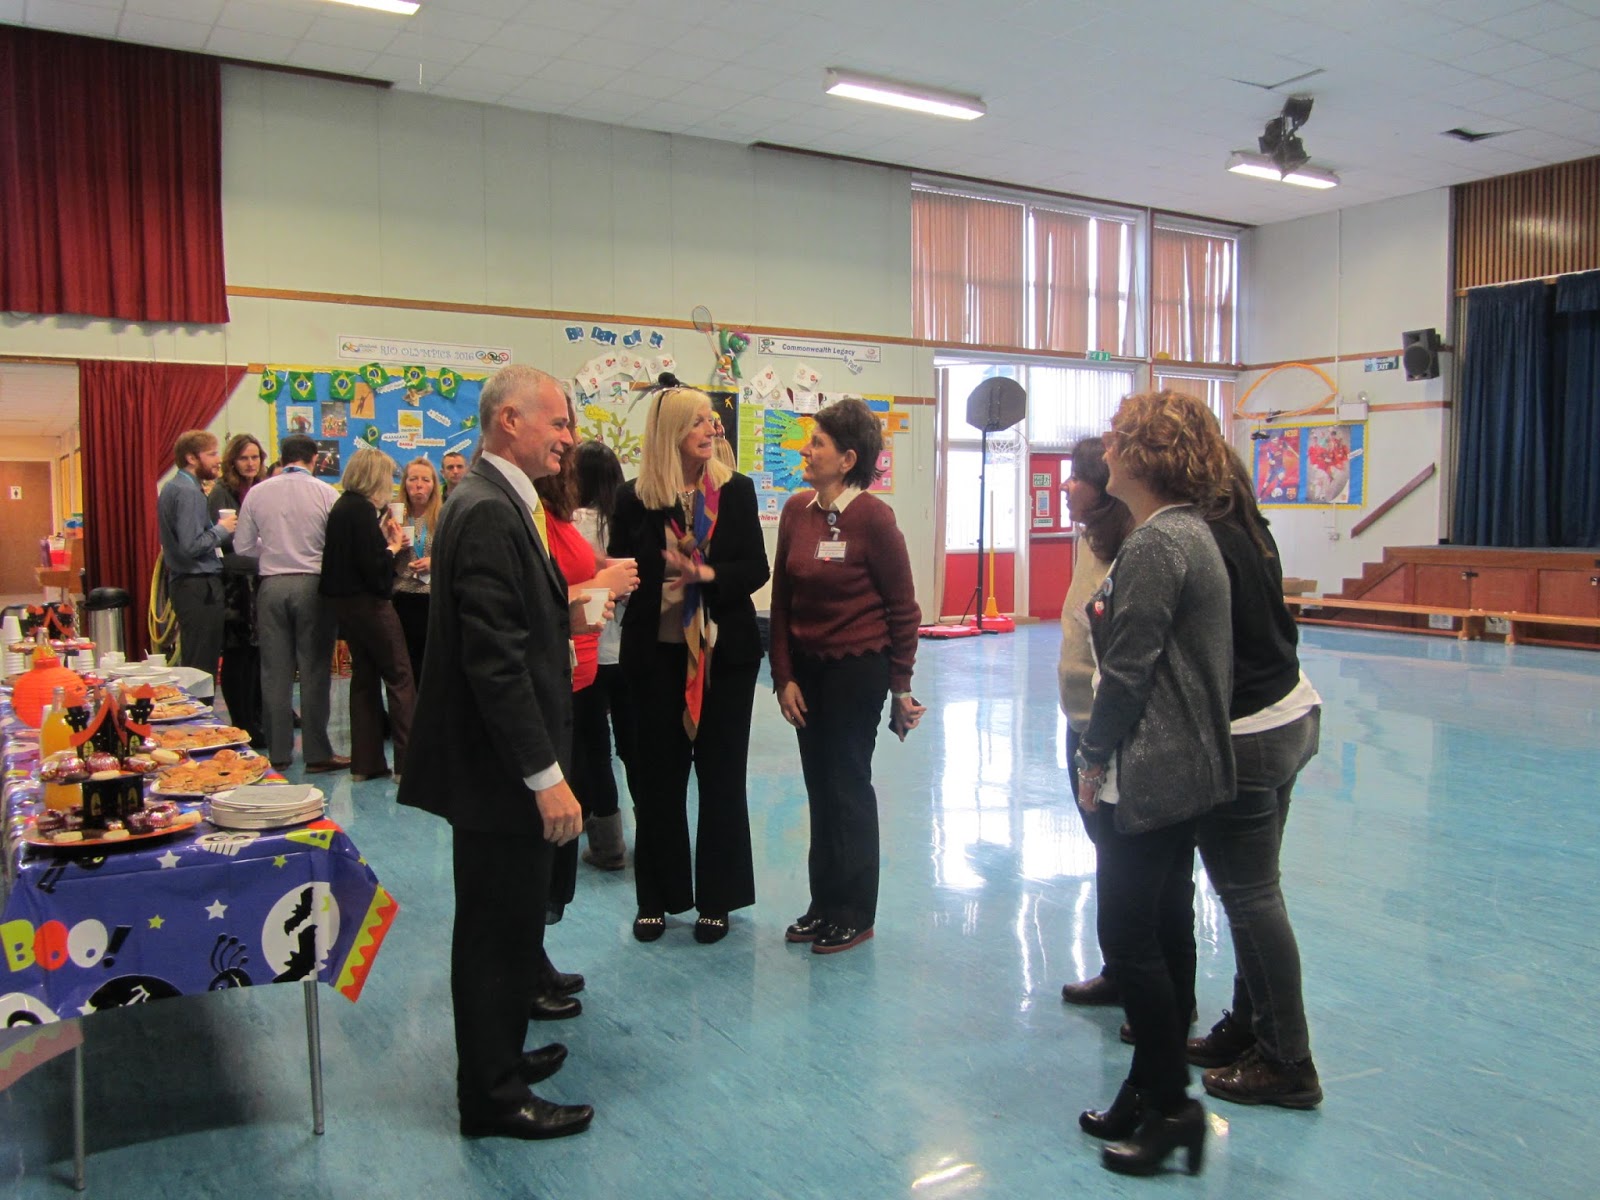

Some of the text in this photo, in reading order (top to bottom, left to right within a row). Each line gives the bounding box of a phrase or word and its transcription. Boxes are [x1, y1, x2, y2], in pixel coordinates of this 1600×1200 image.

[380, 345, 398, 356] RIO
[401, 347, 451, 360] OLYMPICS
[455, 351, 475, 361] 2016
[782, 344, 855, 356] Commonwealth Legacy
[0, 919, 133, 972] BOO!
